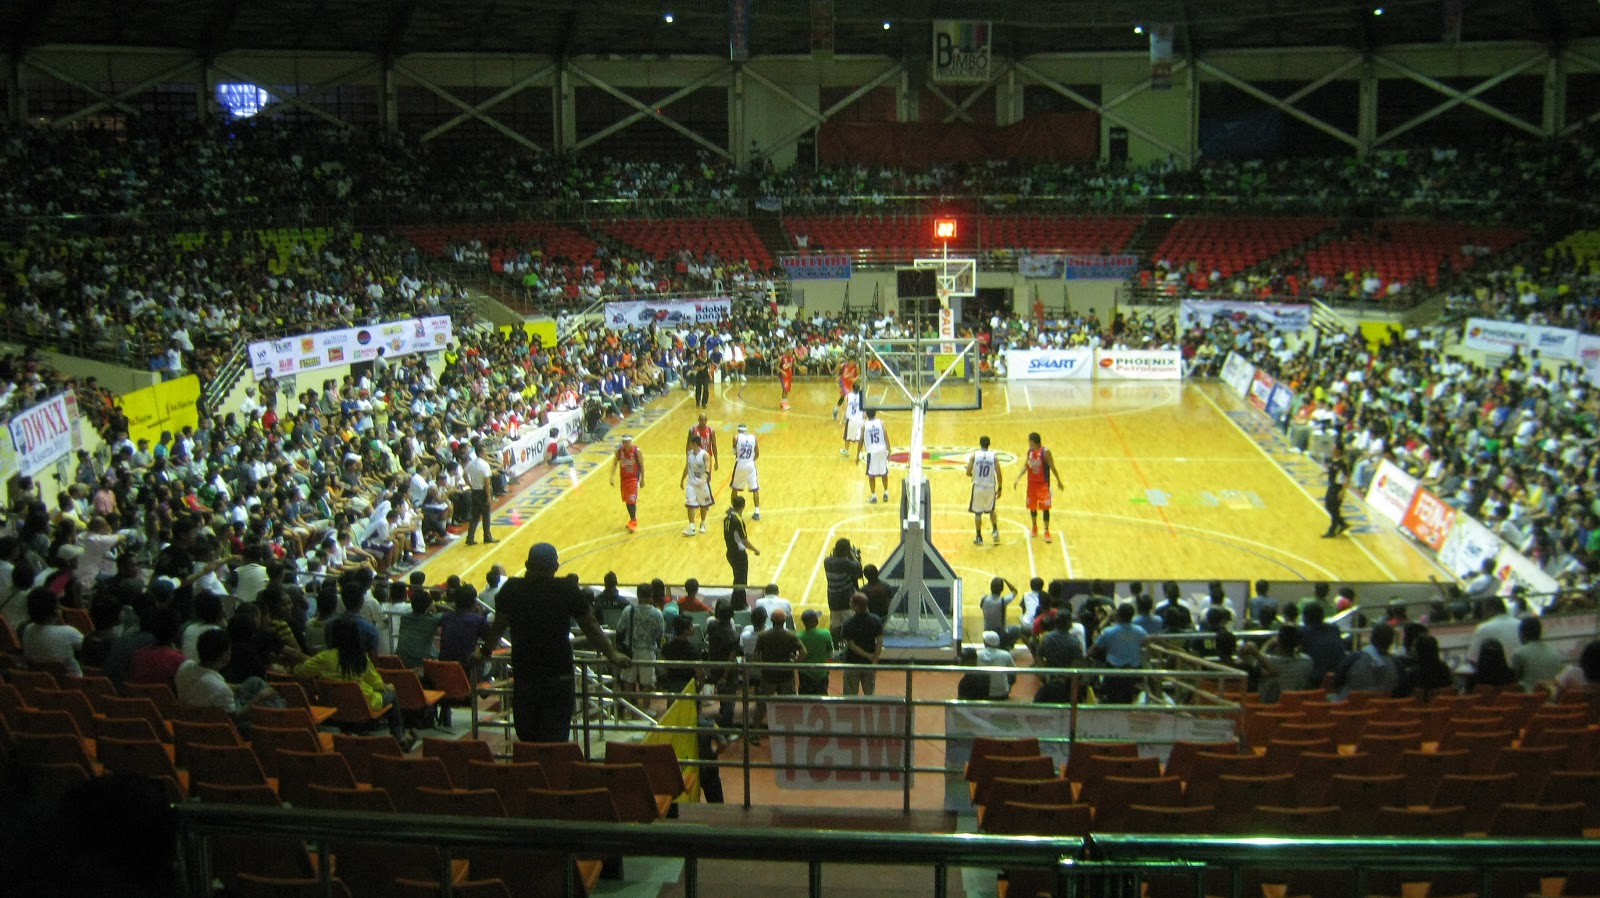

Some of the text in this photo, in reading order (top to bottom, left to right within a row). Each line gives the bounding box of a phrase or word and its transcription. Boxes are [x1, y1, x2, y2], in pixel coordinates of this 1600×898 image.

[1028, 358, 1077, 373] SMART
[1116, 357, 1175, 366] PHOENIX
[22, 400, 68, 453] DWNX
[870, 432, 879, 444] 15
[979, 465, 990, 478] 10
